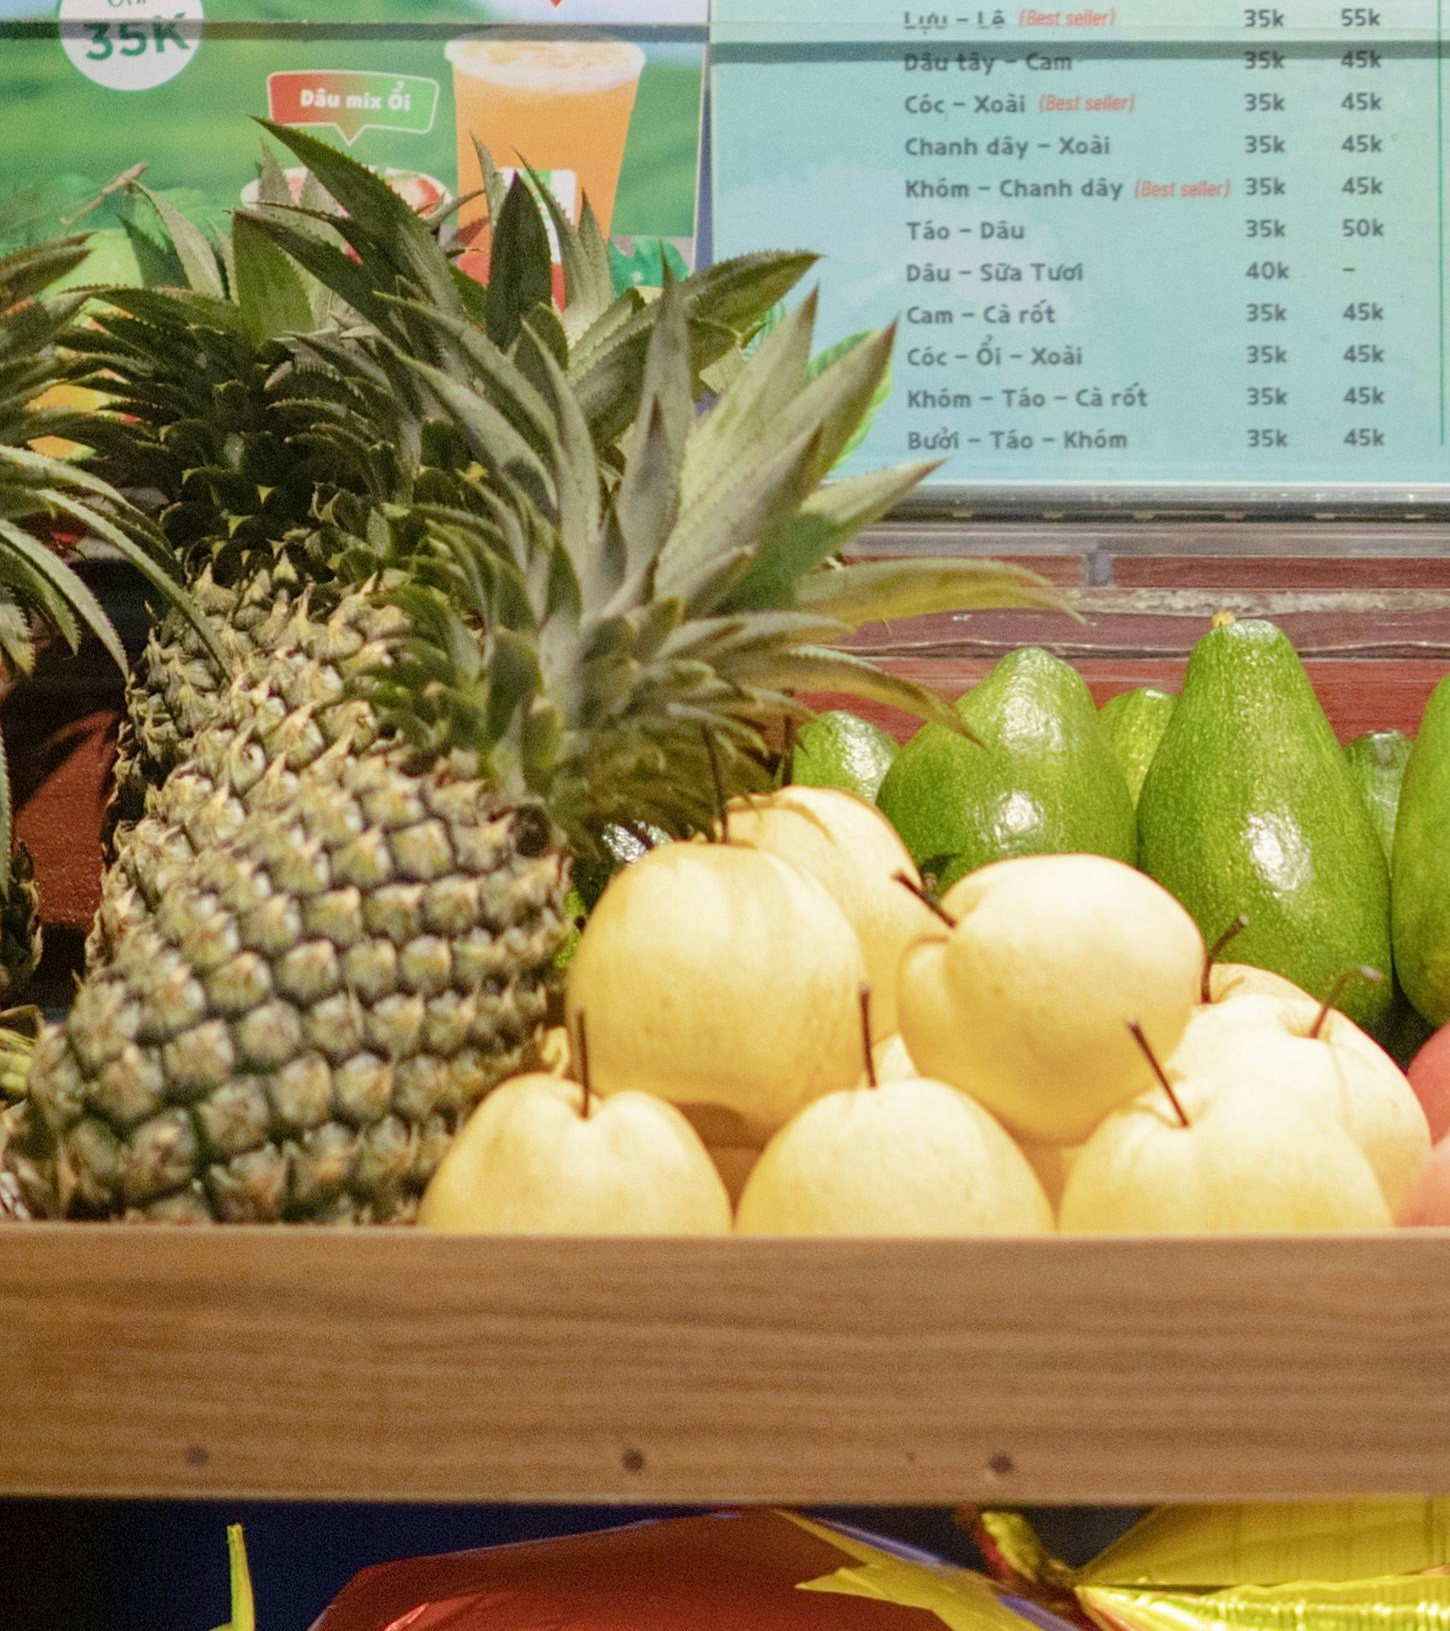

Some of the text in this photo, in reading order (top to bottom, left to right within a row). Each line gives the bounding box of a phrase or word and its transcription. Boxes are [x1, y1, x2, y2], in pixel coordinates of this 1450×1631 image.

[300, 81, 411, 111] Dâu mix Ổi
